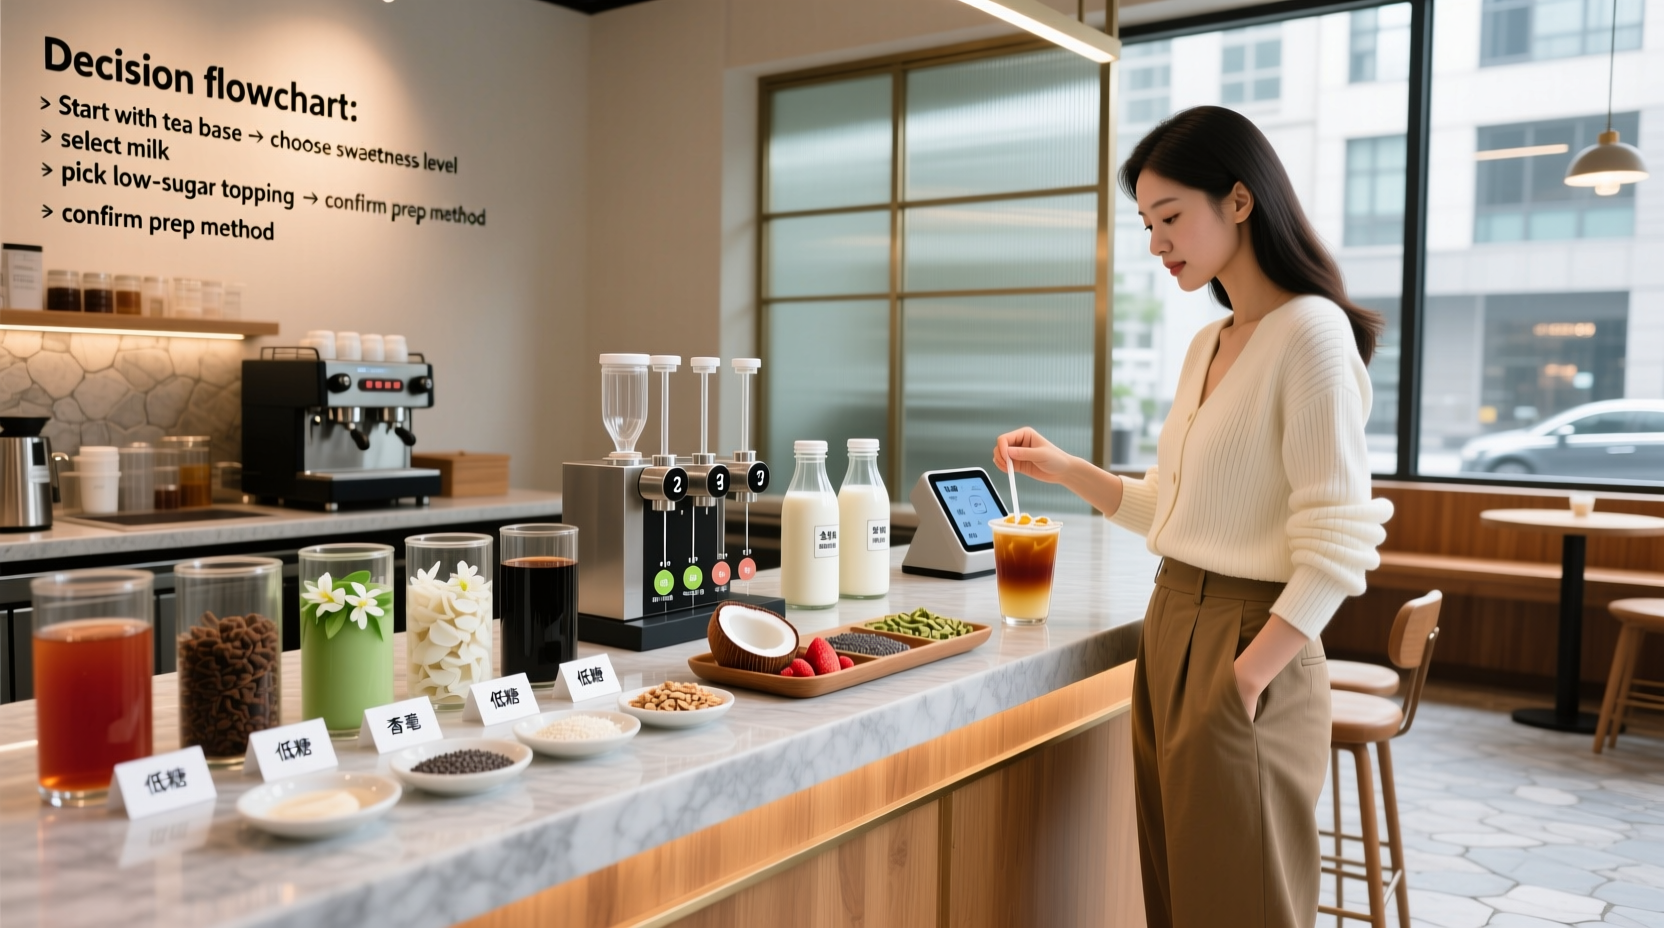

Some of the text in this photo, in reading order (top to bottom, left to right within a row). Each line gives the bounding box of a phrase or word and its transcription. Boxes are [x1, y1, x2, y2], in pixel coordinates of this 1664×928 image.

[44, 35, 358, 123] Decision flowchart:
[58, 94, 110, 123] Start
[113, 107, 158, 129] with
[161, 112, 193, 135] tea
[198, 115, 243, 143] base
[269, 129, 332, 157] choose
[423, 151, 458, 175] level
[60, 129, 171, 162] select milk
[61, 160, 487, 227] pick low-sugar topping confirm prep method
[61, 204, 275, 242] confirm prep method
[673, 476, 682, 493] 2
